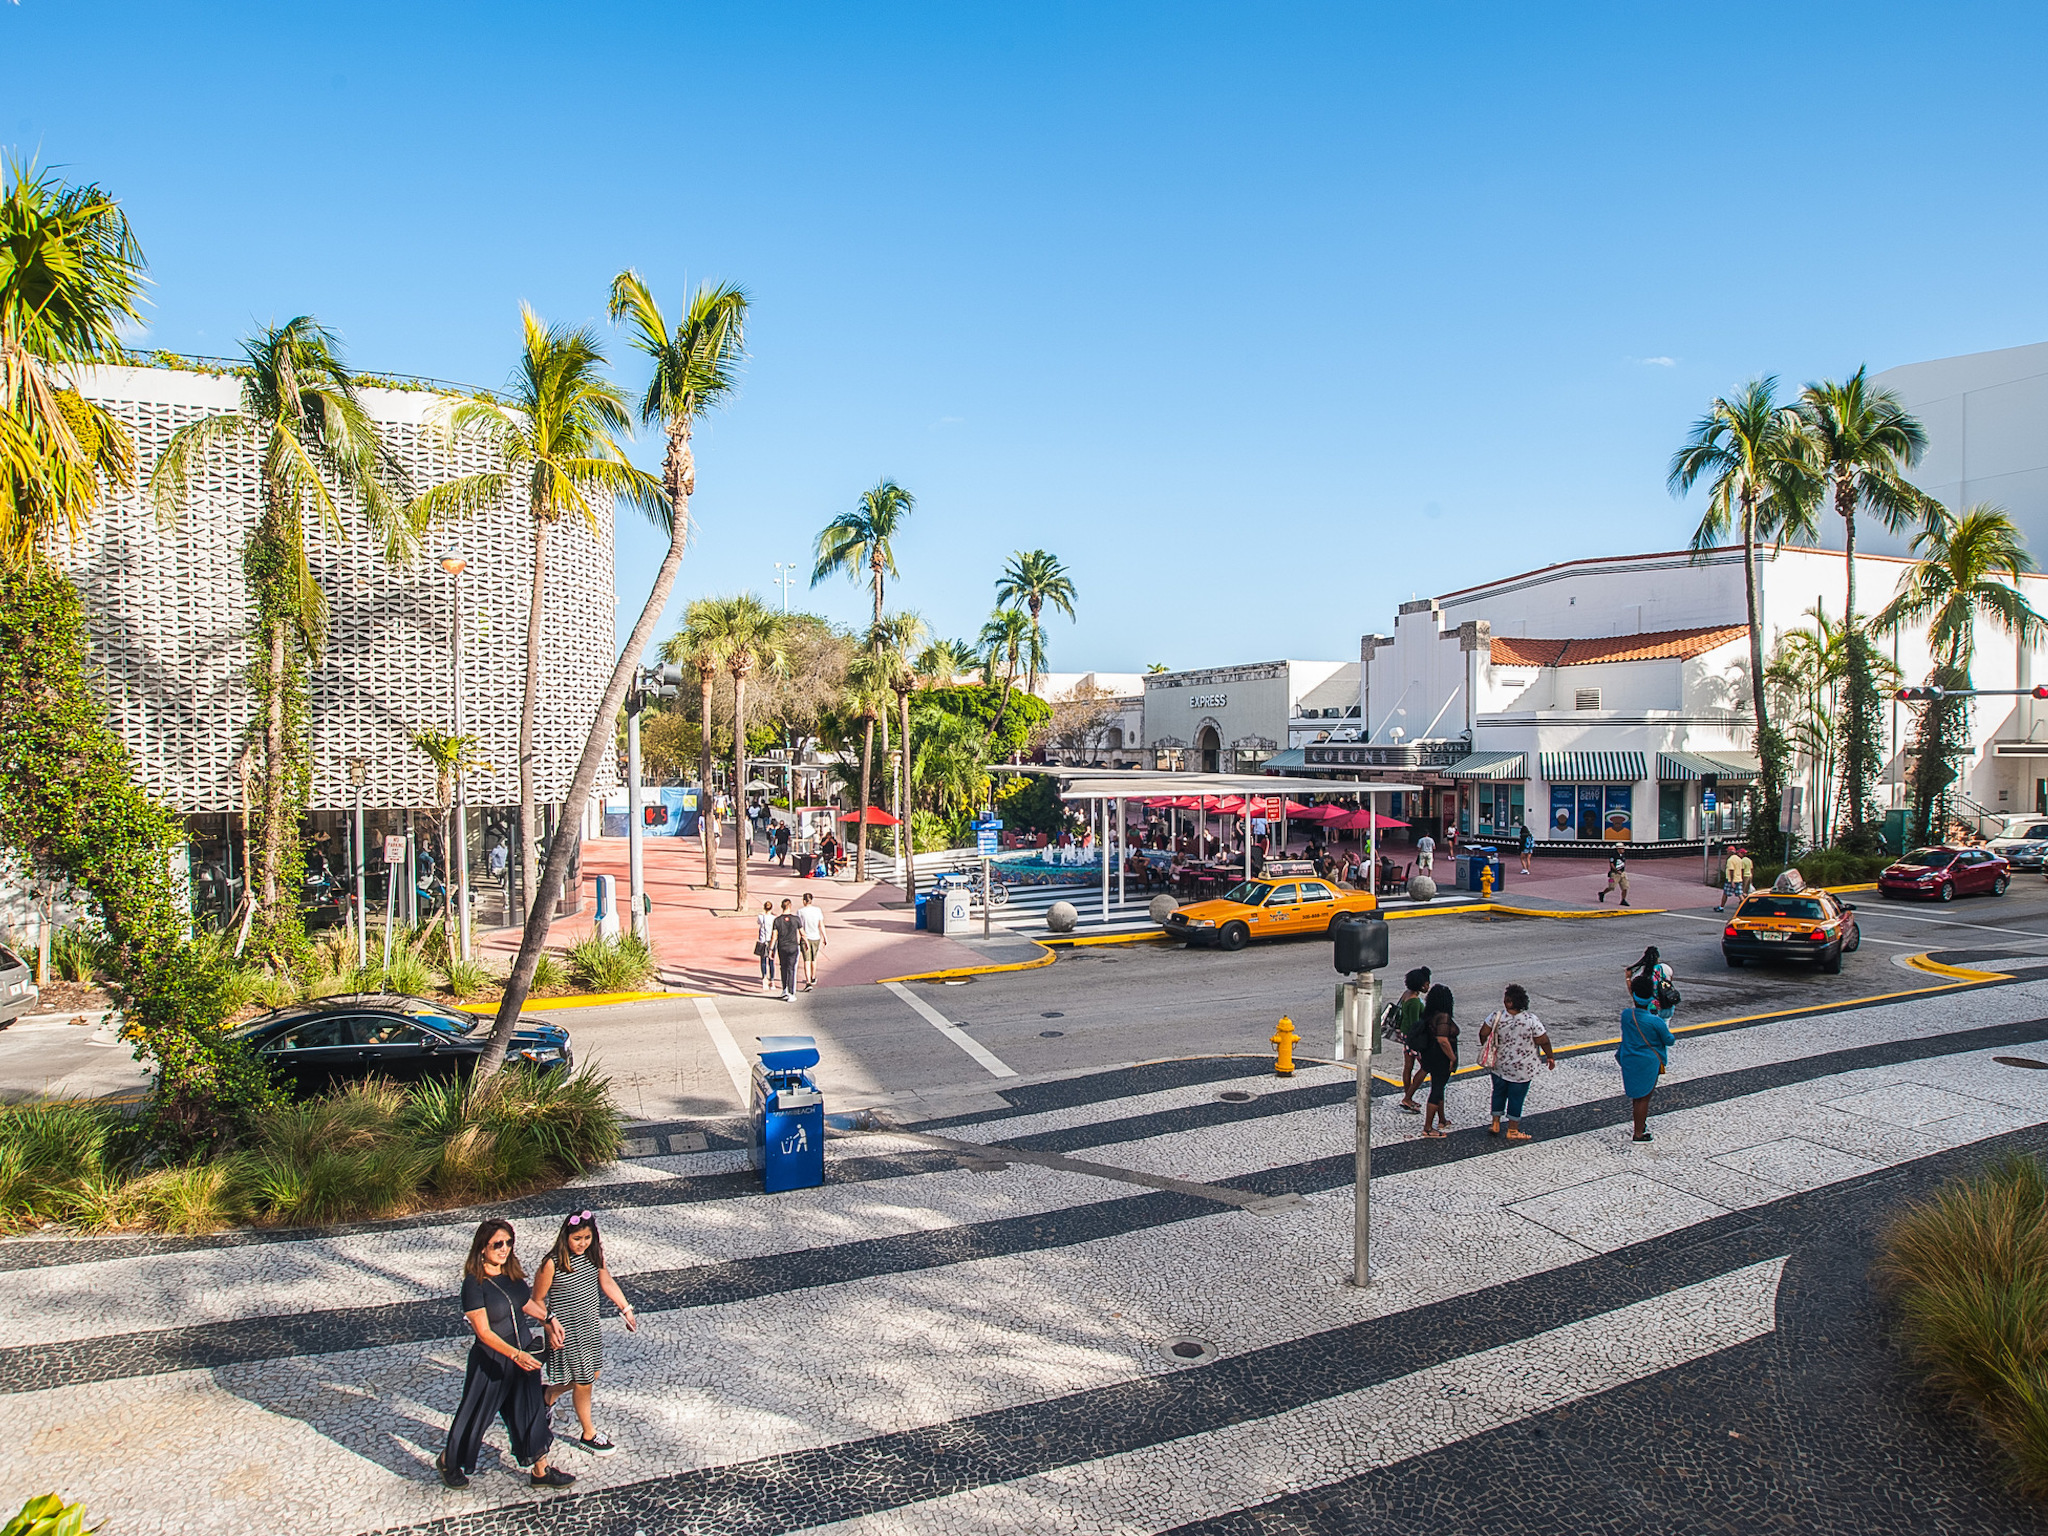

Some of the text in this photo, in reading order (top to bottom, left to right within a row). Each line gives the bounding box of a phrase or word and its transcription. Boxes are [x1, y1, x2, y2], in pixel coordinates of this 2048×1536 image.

[1189, 694, 1227, 708] EXPRESS
[1311, 749, 1388, 765] COLONY
[660, 808, 667, 822] 5
[1271, 864, 1284, 872] 20
